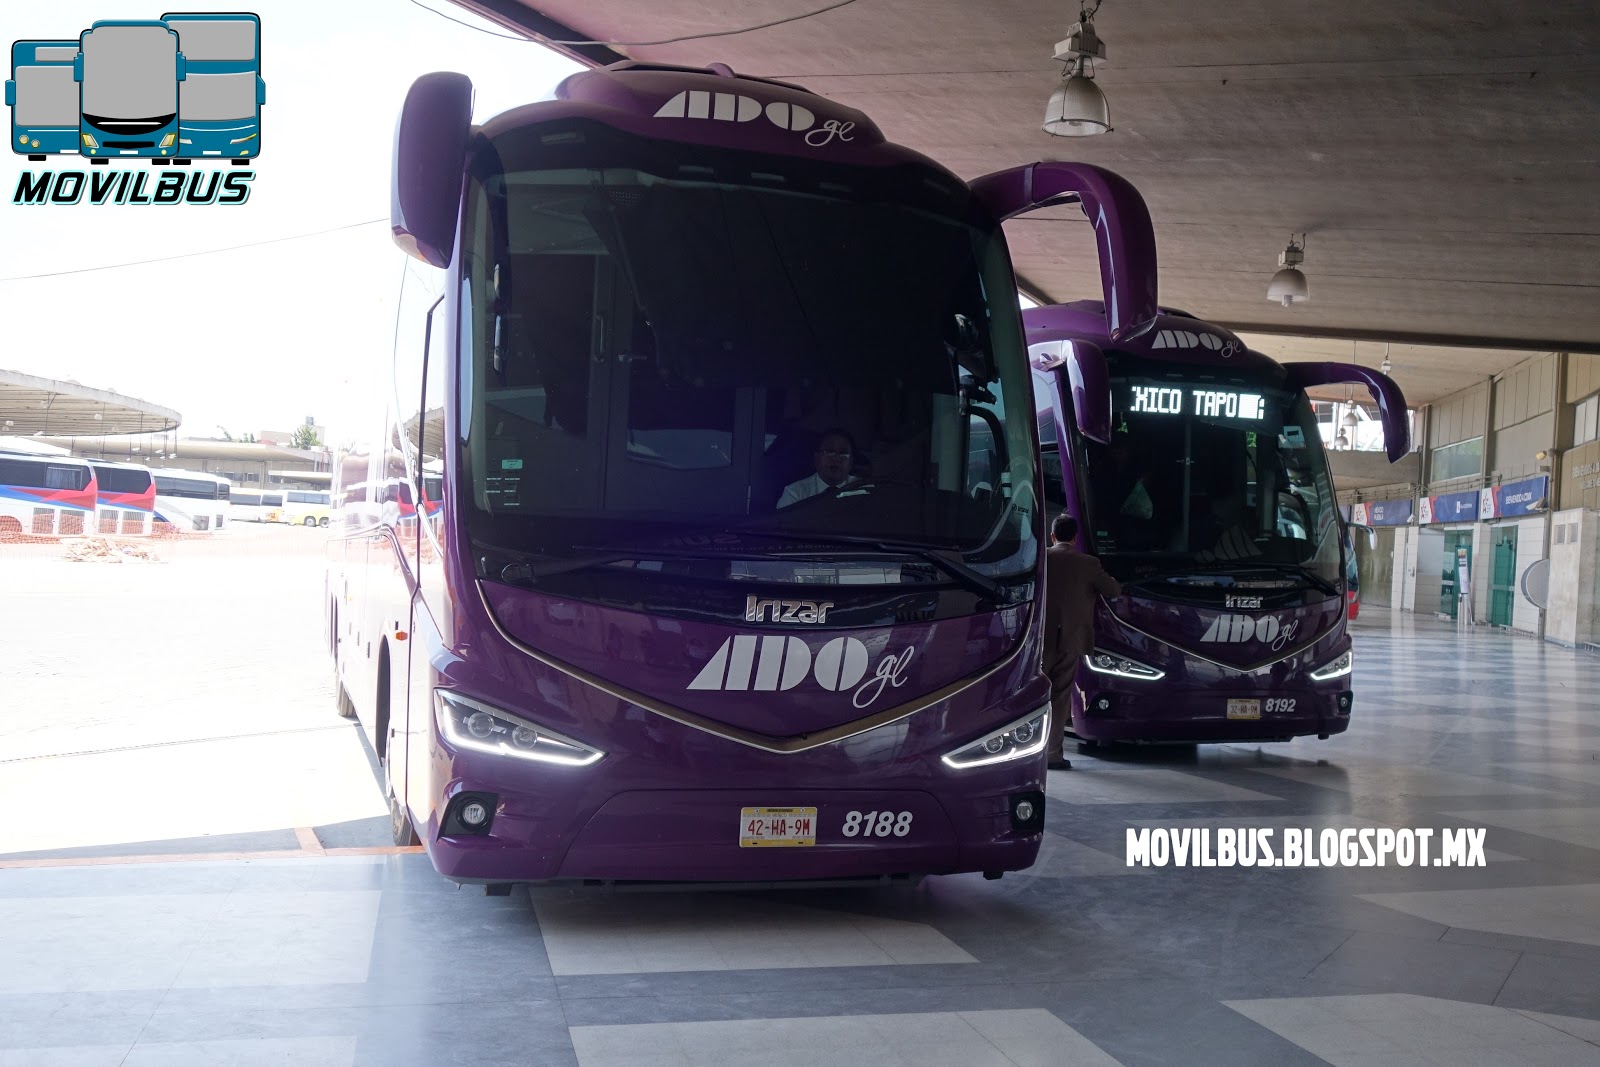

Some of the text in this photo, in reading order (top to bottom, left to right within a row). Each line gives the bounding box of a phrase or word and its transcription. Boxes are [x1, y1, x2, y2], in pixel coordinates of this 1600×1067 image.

[653, 90, 815, 132] ADO
[1151, 330, 1223, 351] ADO
[1130, 385, 1238, 418] XICO TAPO
[745, 594, 835, 624] Irizar
[1225, 594, 1264, 608] Irizar
[1200, 614, 1280, 643] ADO
[686, 635, 869, 692] ADO
[1265, 698, 1297, 713] 8192
[747, 818, 811, 836] 42-HA-9M
[841, 810, 914, 838] 8188
